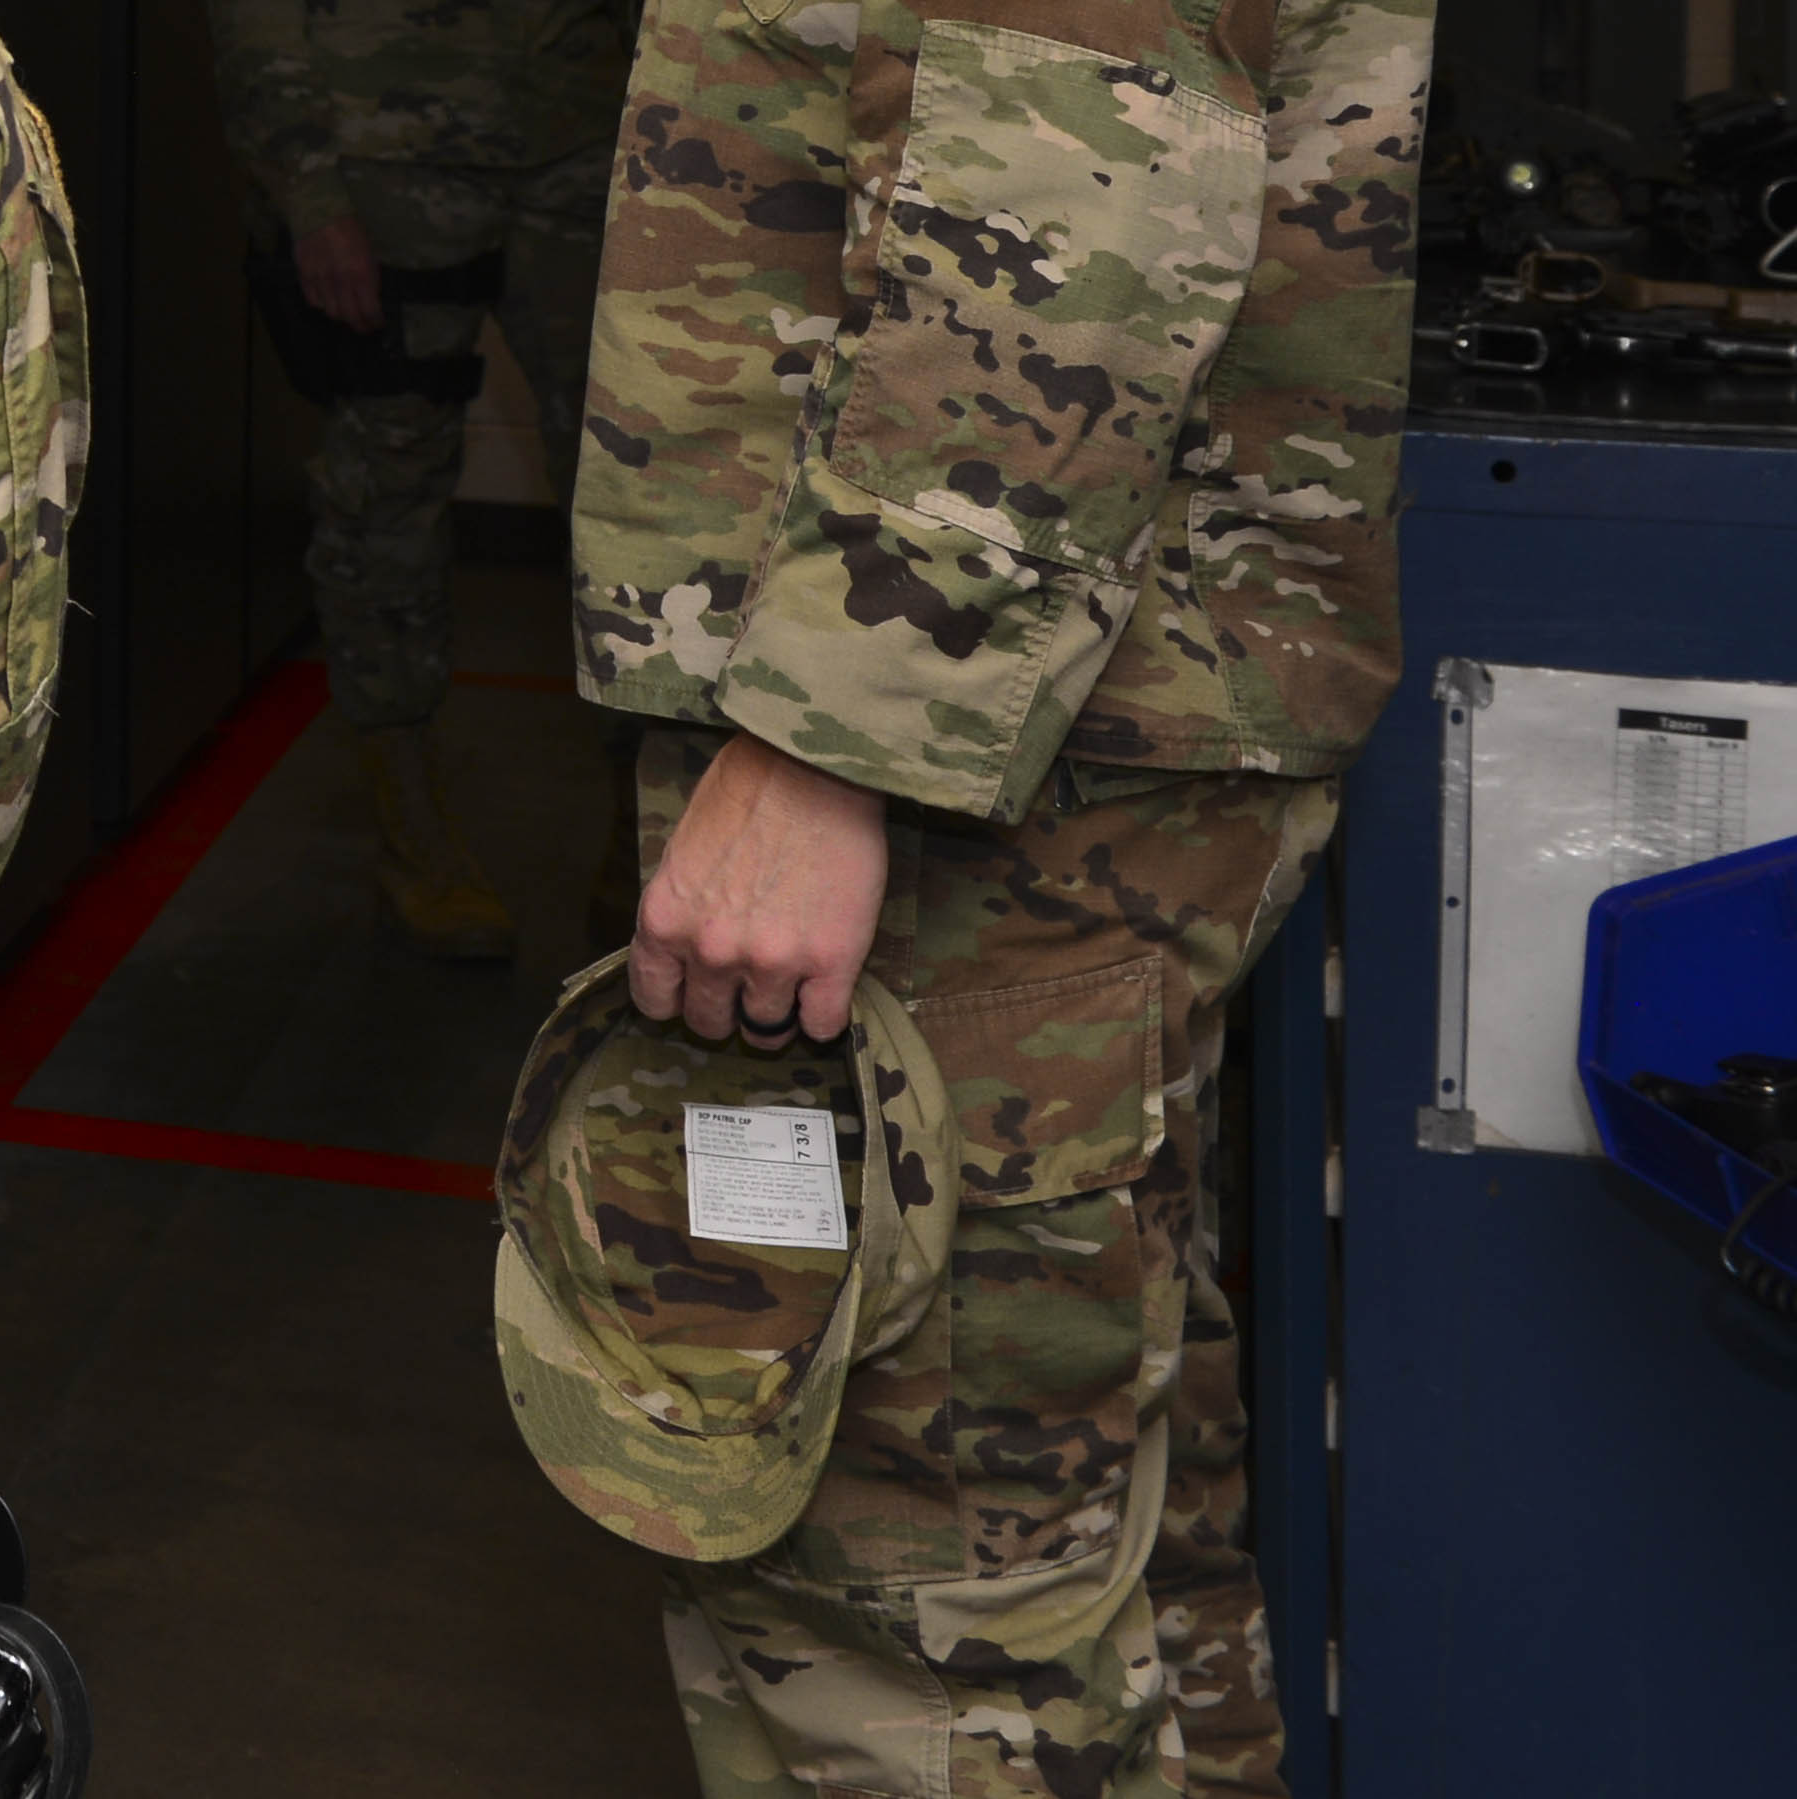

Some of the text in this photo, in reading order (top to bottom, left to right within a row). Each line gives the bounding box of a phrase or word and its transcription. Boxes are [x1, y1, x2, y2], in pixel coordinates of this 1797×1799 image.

[1657, 715, 1709, 734] Tasers
[713, 1114, 736, 1124] PATROL
[738, 1116, 752, 1126] CAP
[794, 1123, 811, 1160] 7 3/8
